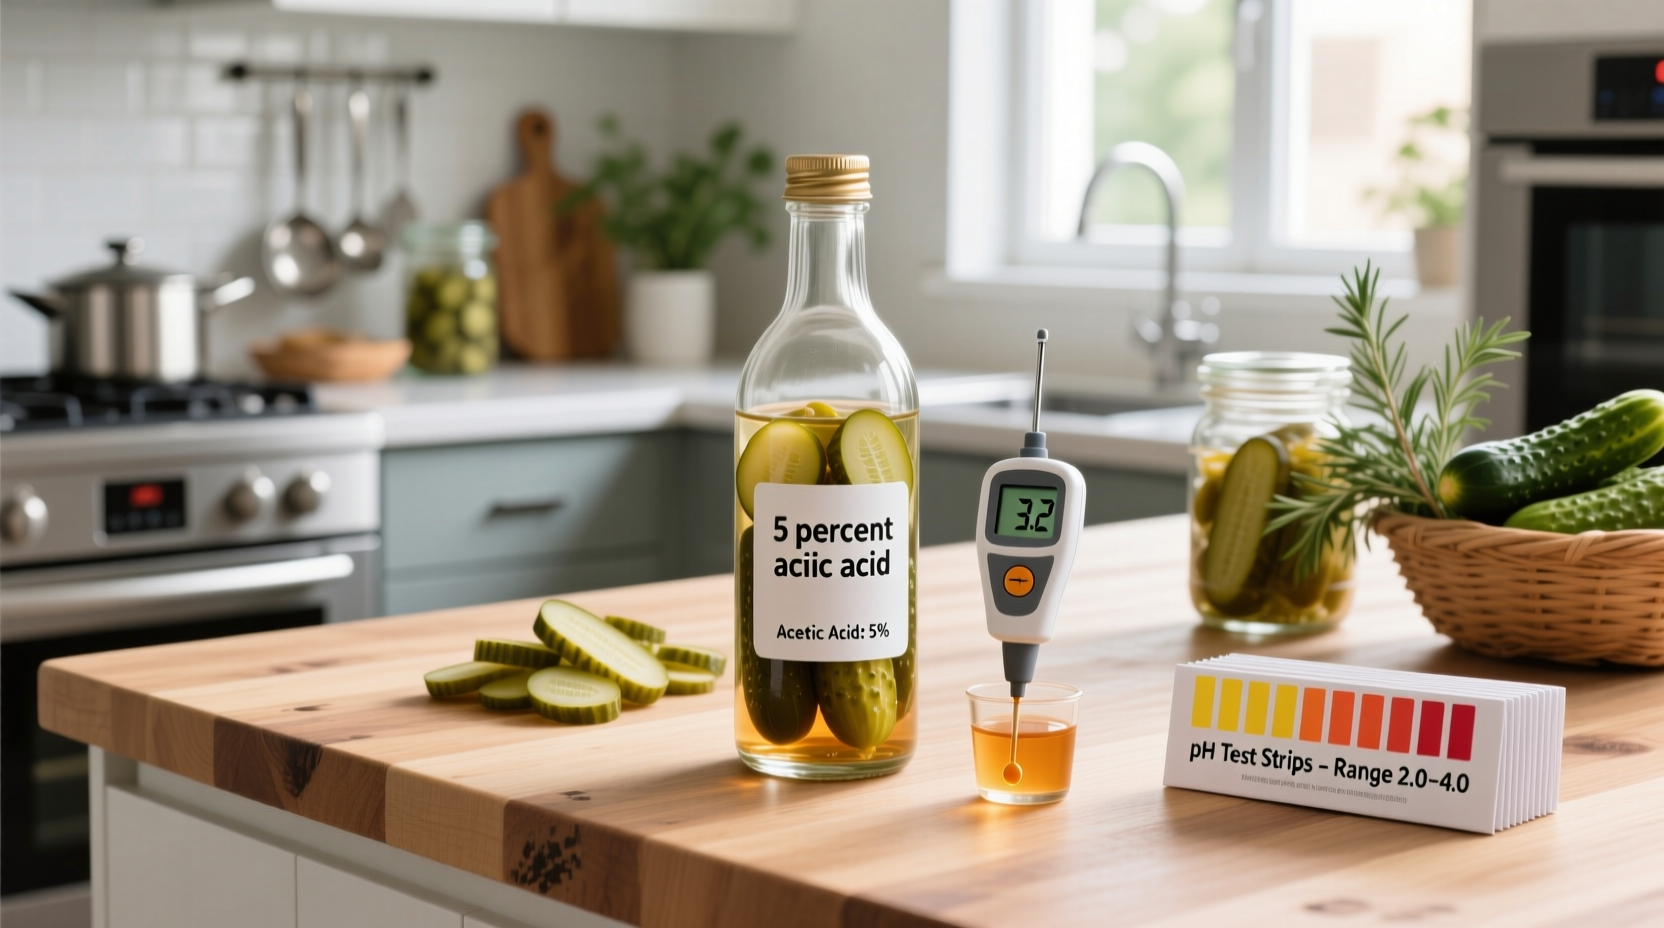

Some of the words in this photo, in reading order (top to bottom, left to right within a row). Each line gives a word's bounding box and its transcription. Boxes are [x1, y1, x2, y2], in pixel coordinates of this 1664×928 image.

[773, 515, 789, 543] 5
[795, 517, 894, 550] percent
[1014, 497, 1056, 533] 3.2
[773, 551, 833, 579] aciic
[839, 548, 890, 578] acid
[776, 623, 825, 641] Acetic
[827, 624, 866, 641] Acid:
[868, 622, 890, 639] 5%
[1189, 740, 1216, 763] pH
[1220, 742, 1258, 768] Test
[1260, 747, 1313, 777] Strips
[1333, 757, 1394, 789] Range
